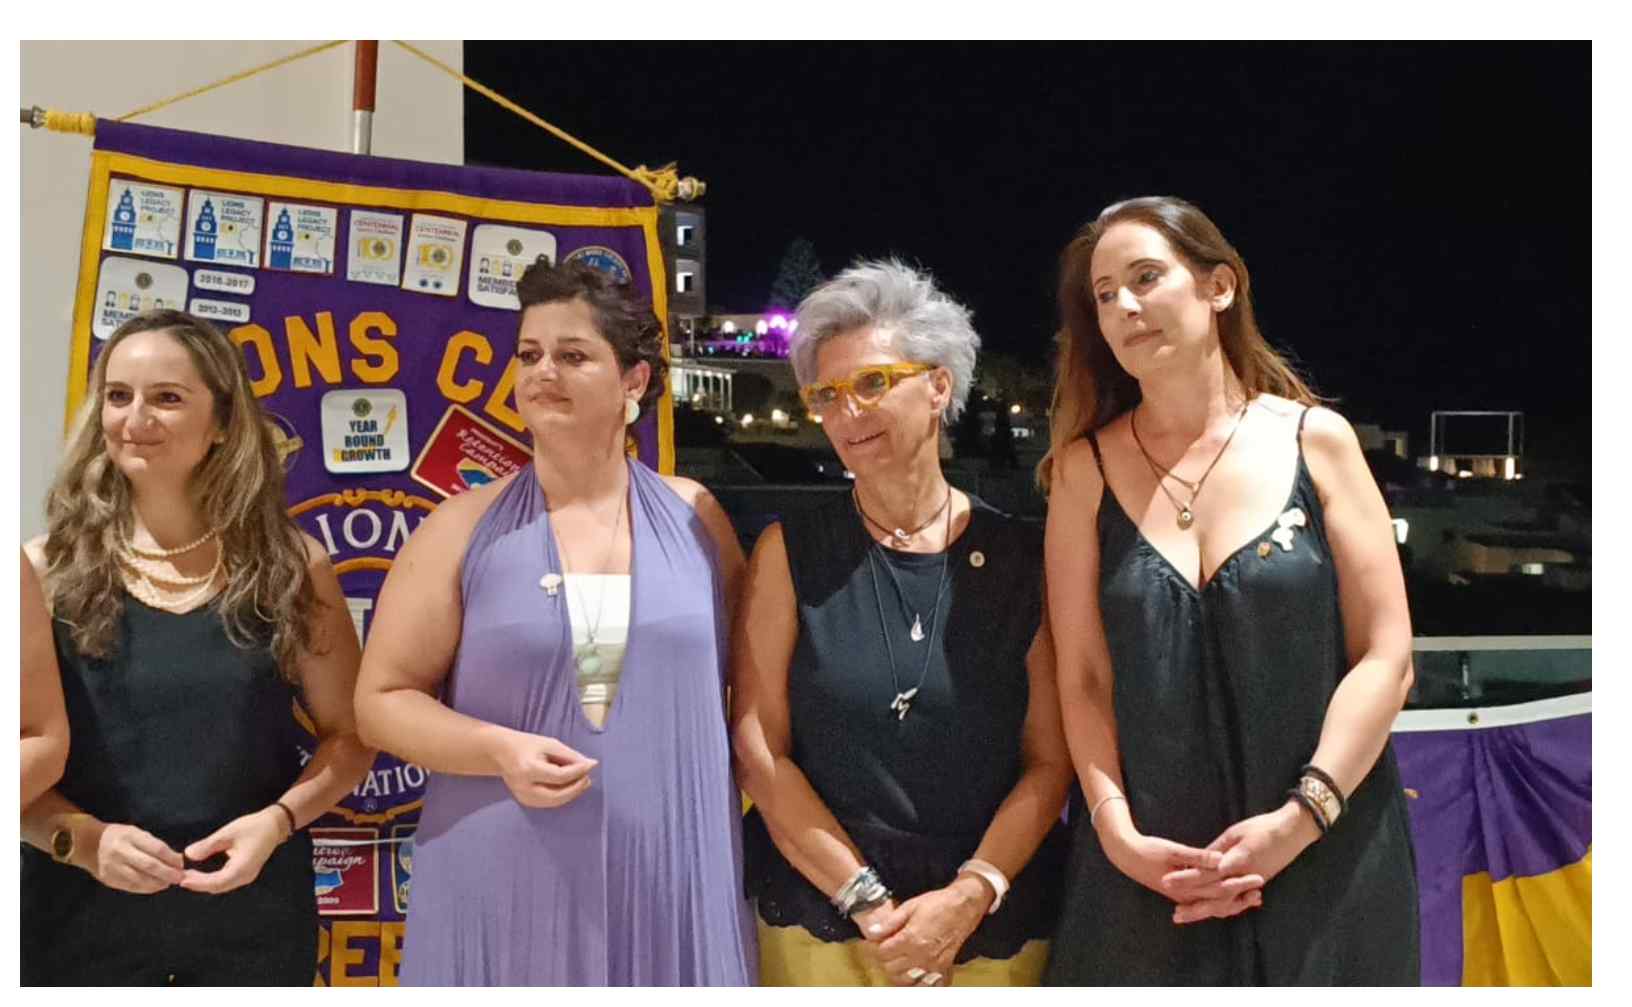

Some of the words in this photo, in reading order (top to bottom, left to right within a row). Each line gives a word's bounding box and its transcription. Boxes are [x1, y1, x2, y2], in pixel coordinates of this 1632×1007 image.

[222, 207, 251, 216] LEGACY
[221, 215, 256, 225] PROJECT
[229, 311, 400, 398] ONS
[349, 420, 378, 432] YEAR
[344, 434, 385, 447] ROUND
[341, 448, 391, 462] GROWTH
[315, 508, 425, 556] ION
